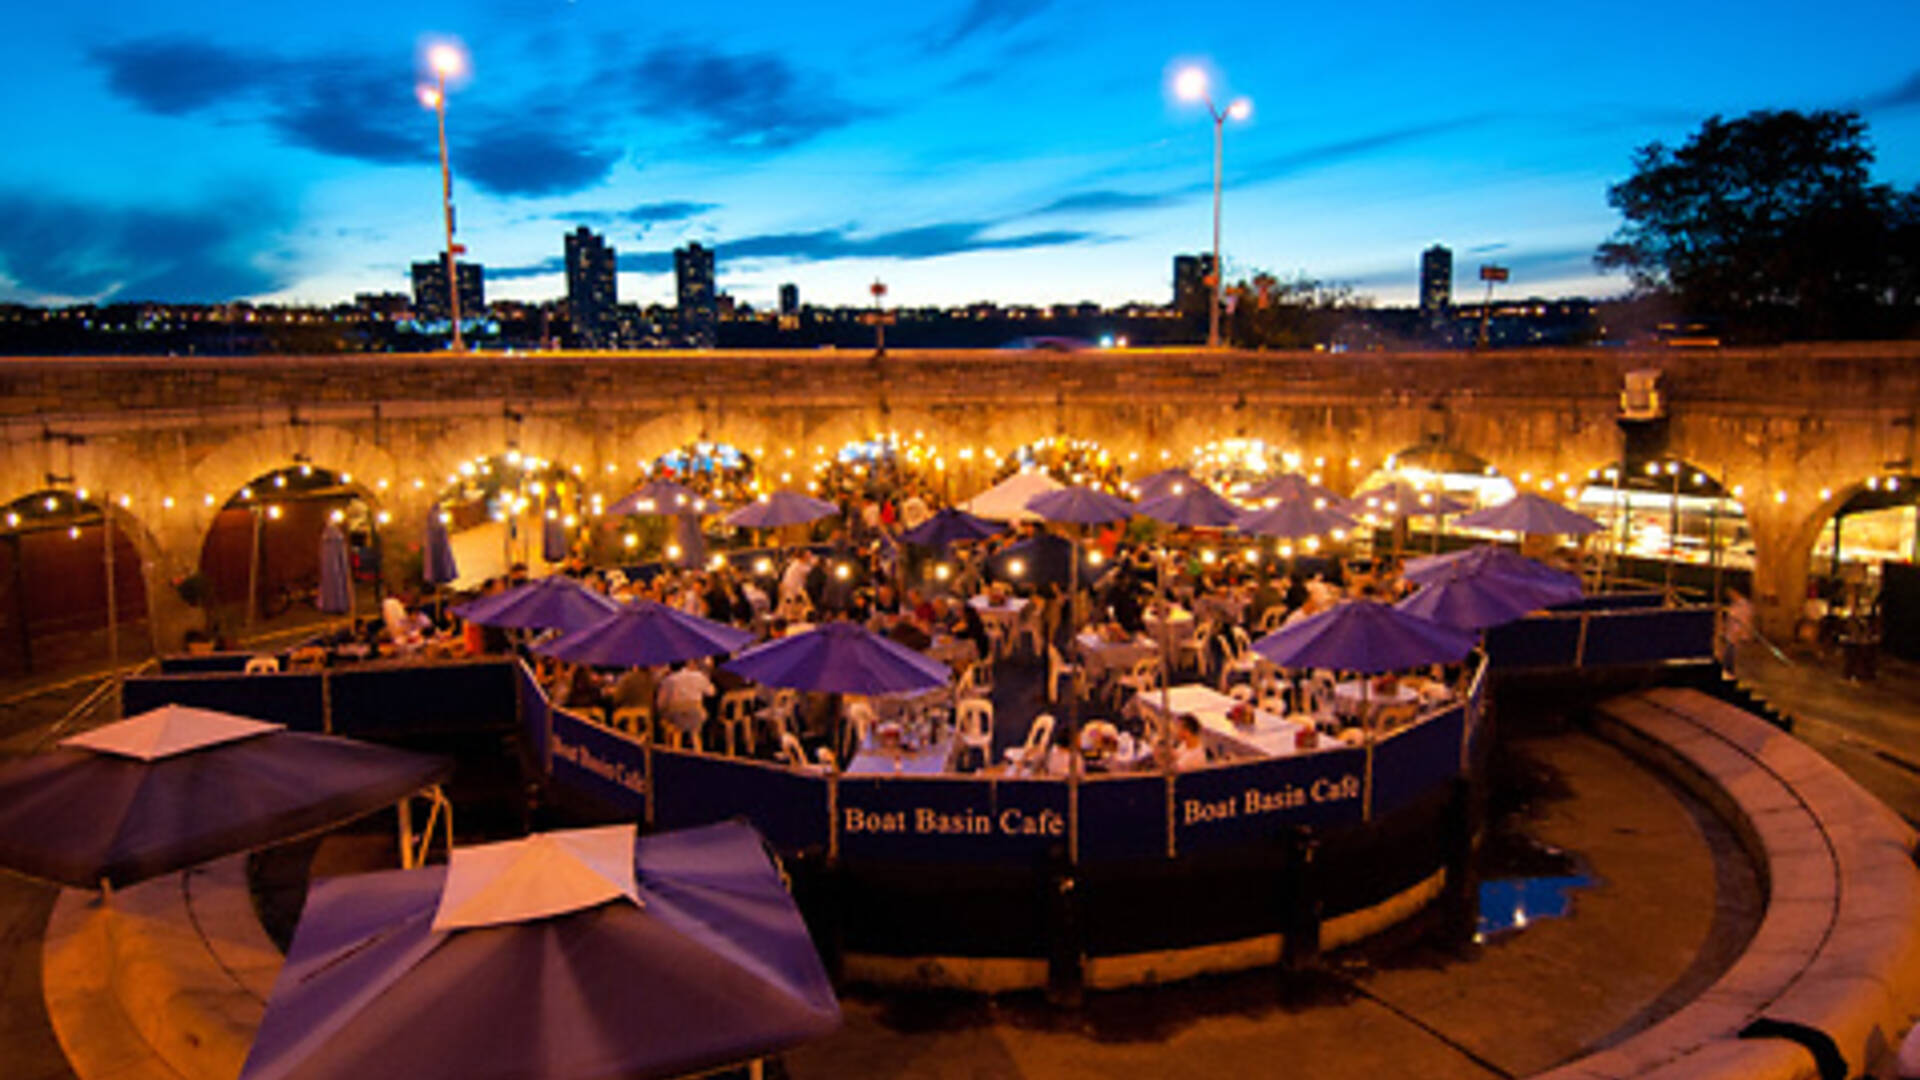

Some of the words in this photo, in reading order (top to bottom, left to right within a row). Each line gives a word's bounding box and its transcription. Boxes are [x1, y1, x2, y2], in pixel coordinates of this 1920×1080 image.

[844, 807, 906, 833] Boat
[914, 807, 991, 834] Basin
[1184, 796, 1237, 825] Boat
[1244, 784, 1306, 815] Basin
